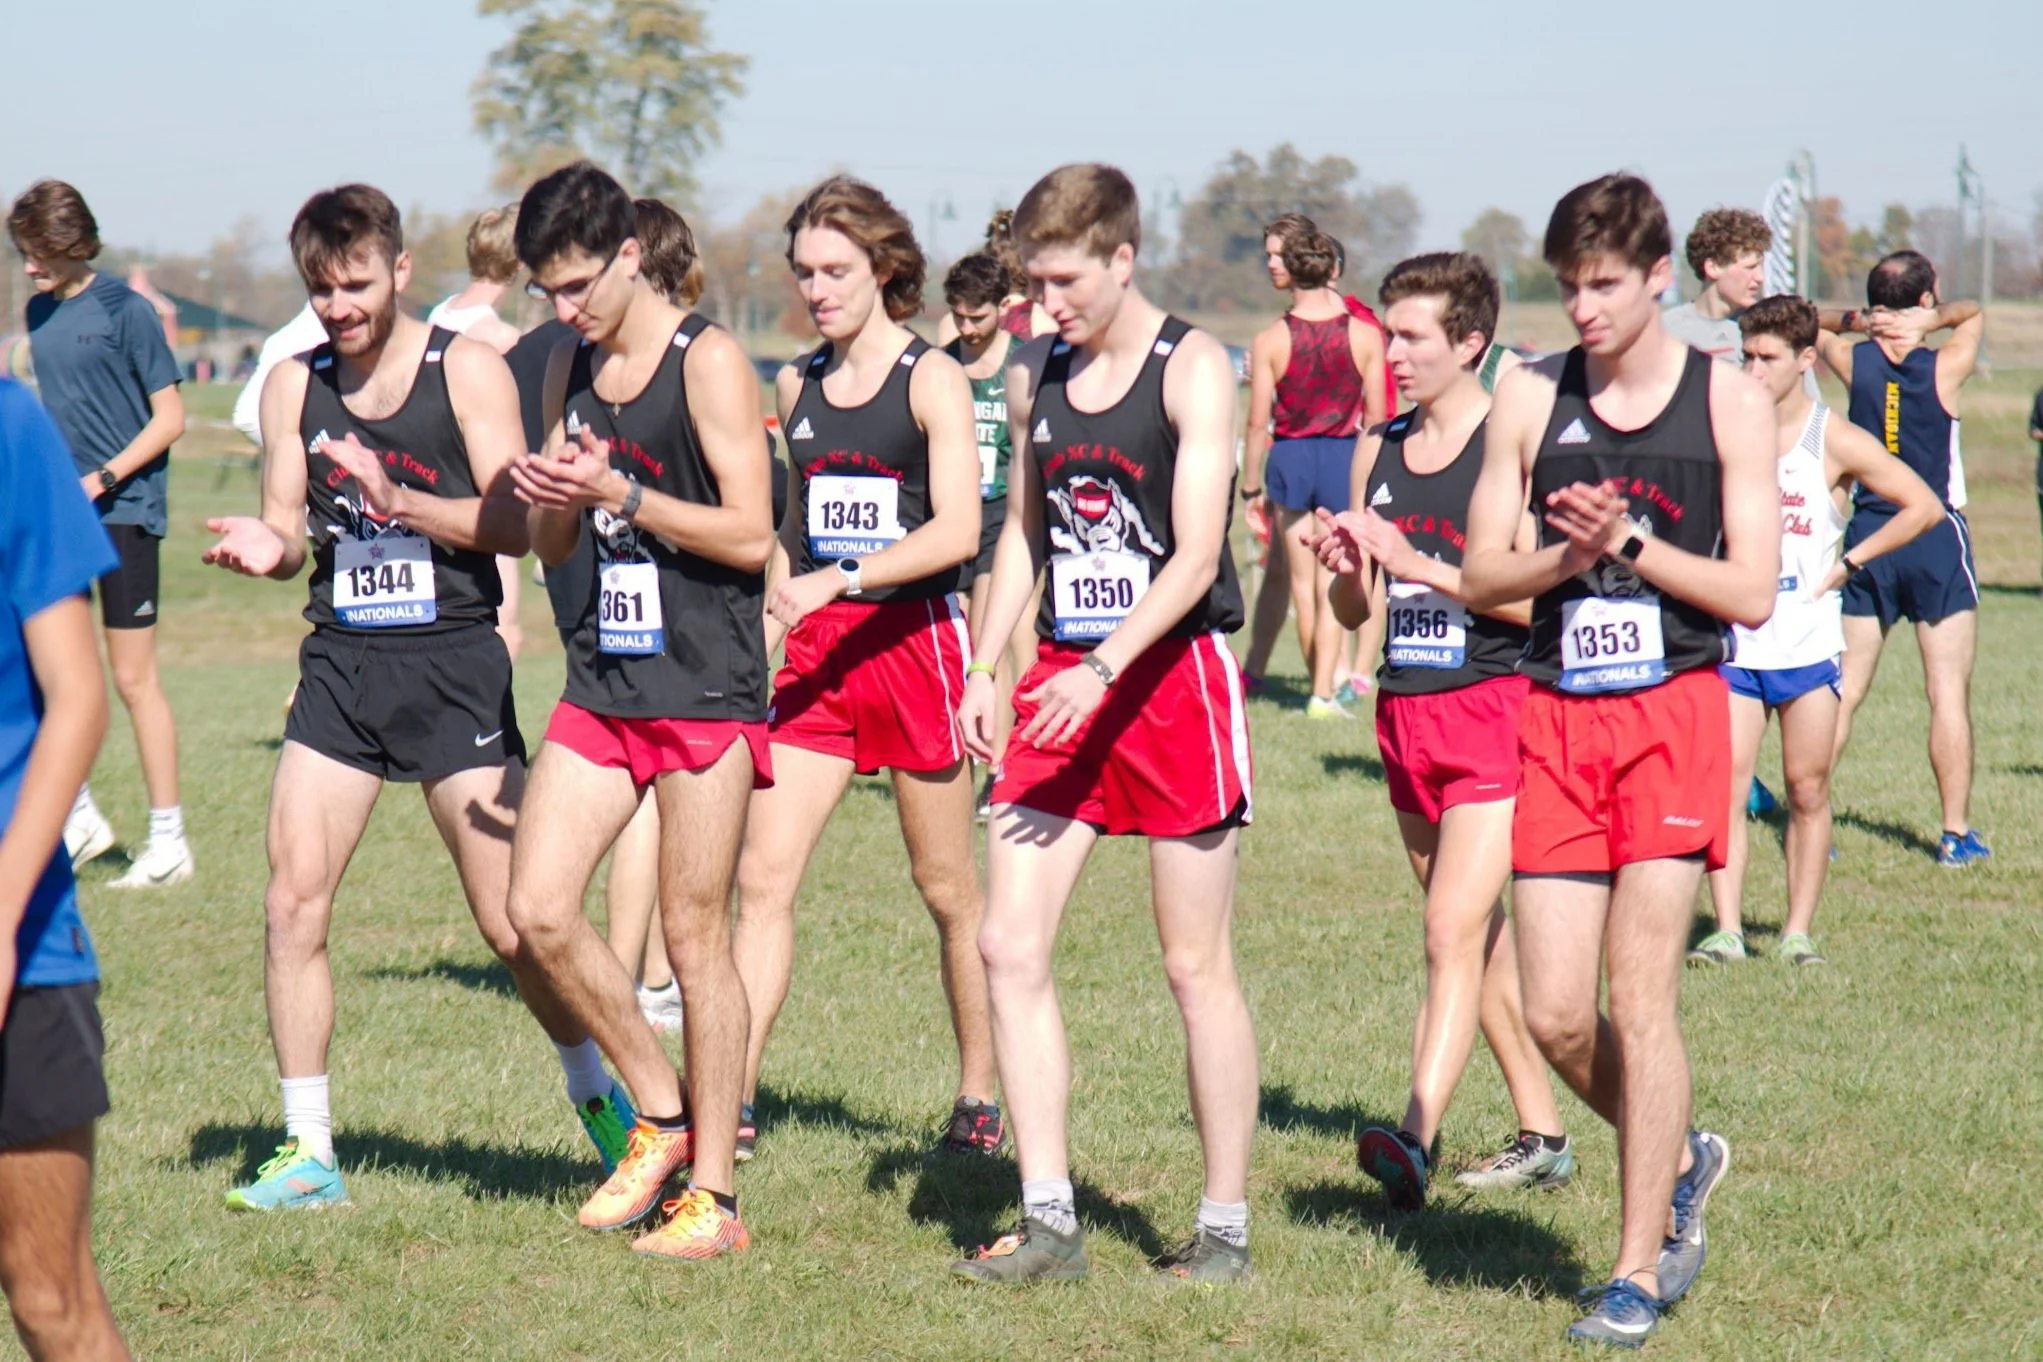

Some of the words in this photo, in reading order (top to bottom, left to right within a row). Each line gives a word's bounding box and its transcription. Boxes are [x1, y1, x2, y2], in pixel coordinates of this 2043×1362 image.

[1885, 381, 1900, 454] MICHIGAN
[326, 466, 351, 488] Clu
[385, 452, 398, 465] &
[400, 453, 440, 486] Track
[1066, 443, 1089, 462] XC
[1091, 443, 1103, 459] &
[1108, 446, 1147, 483] Track
[820, 501, 880, 531] 1343
[1630, 476, 1645, 496] &
[1647, 481, 1685, 524] Track
[347, 563, 416, 598] 1344
[1068, 577, 1134, 609] 1350
[345, 603, 424, 624] NATIONALS
[601, 589, 644, 623] 361
[1063, 618, 1121, 635] NATIONA
[1391, 607, 1449, 640] 1356
[1572, 620, 1641, 660] 1353
[600, 632, 653, 649] TIONALS
[1390, 649, 1453, 665] NATIONALS
[1571, 663, 1652, 687] NATIONALS
